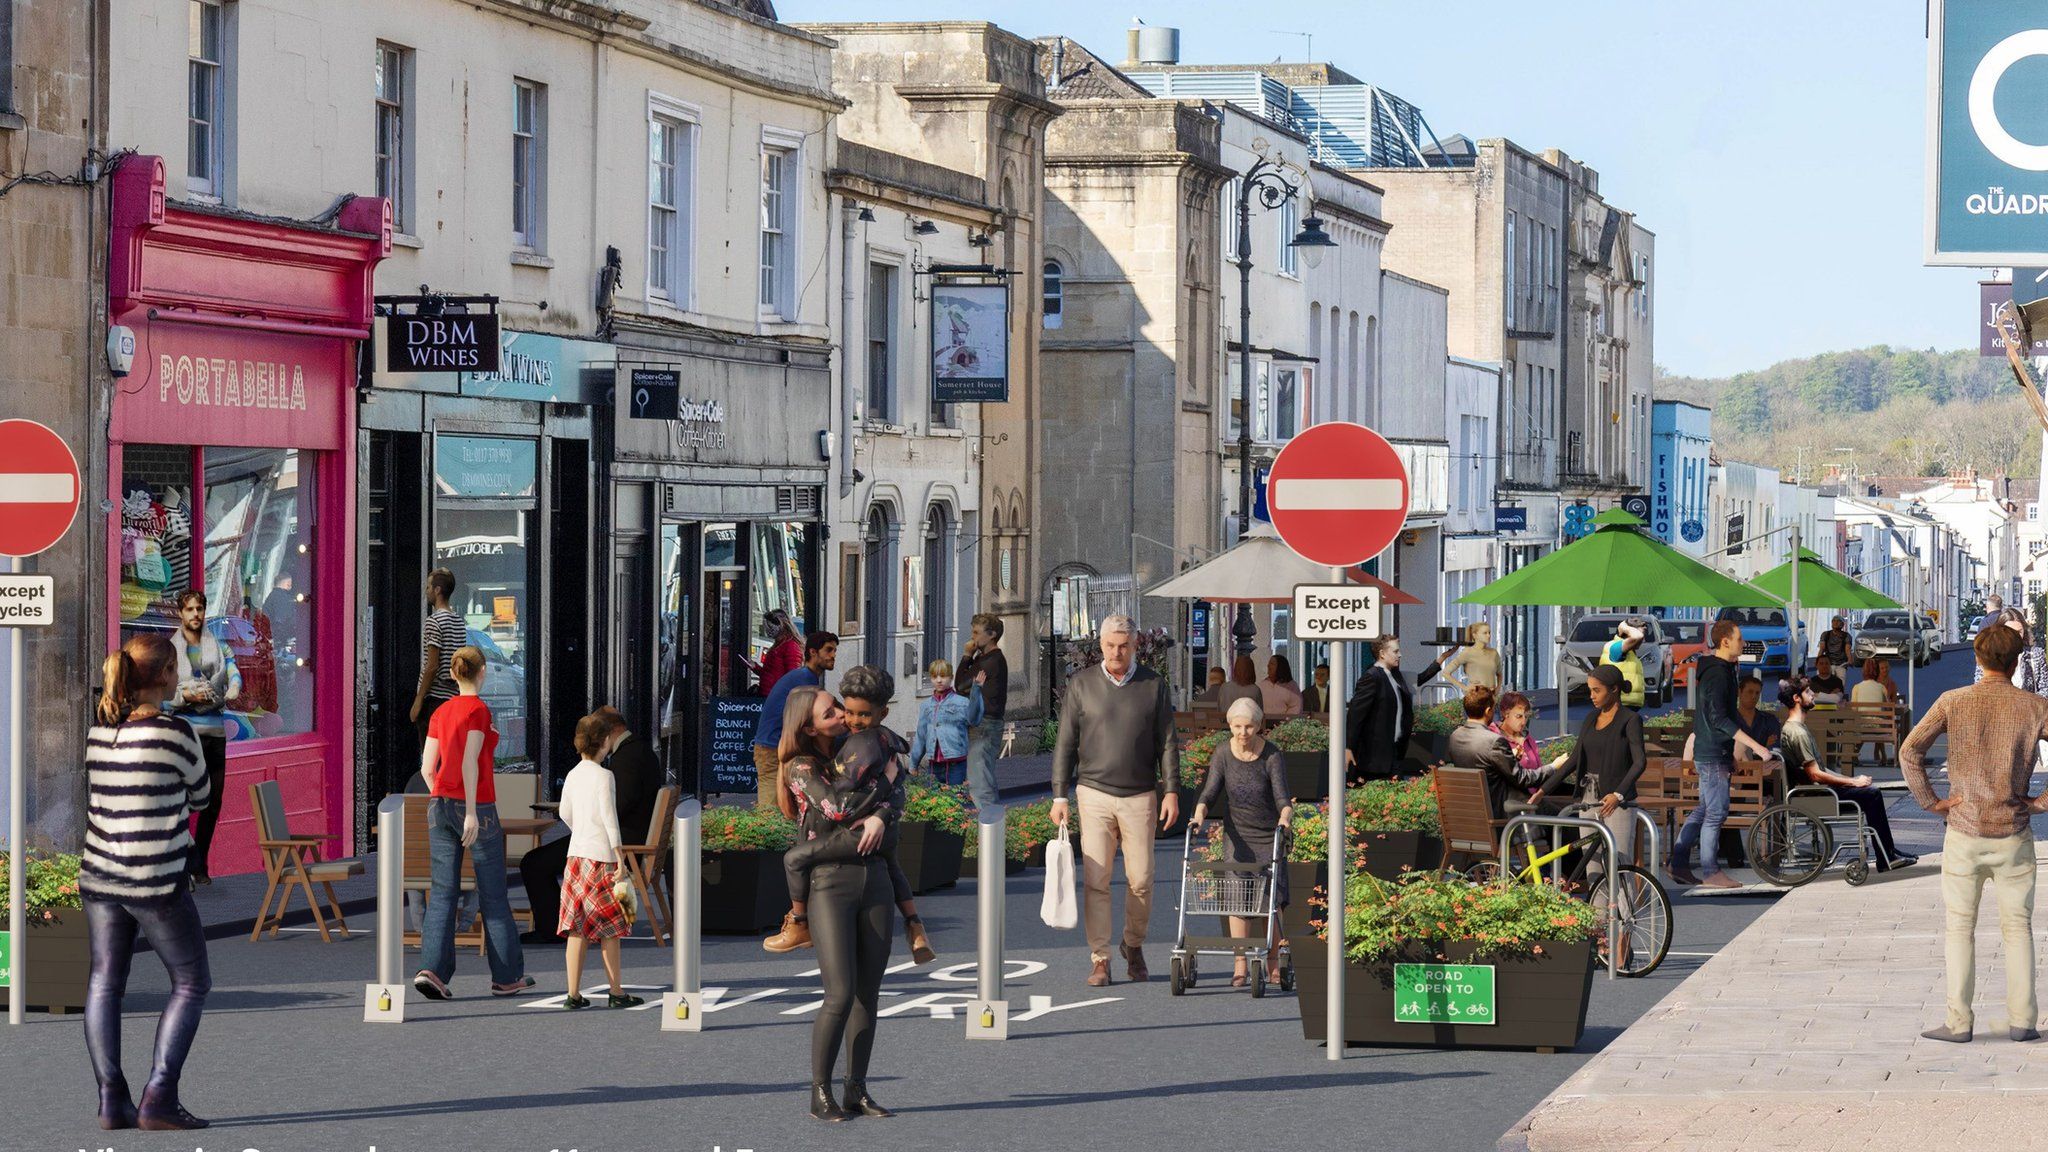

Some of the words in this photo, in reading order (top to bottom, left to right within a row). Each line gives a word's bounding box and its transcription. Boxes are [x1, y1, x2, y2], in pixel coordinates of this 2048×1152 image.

[1988, 186, 2004, 194] THE
[407, 320, 478, 345] DBM
[407, 347, 478, 366] WINES
[160, 354, 306, 410] PORTABELLA
[680, 397, 724, 425] Spicer+Cole
[1305, 595, 1370, 613] Except
[1195, 611, 1203, 621] P
[1307, 616, 1366, 633] cycles
[715, 718, 751, 728] BRUNCH
[715, 730, 743, 739] LUNCH
[713, 741, 745, 751] COFFEE
[712, 752, 737, 762] CAKE
[717, 773, 735, 784] Every
[737, 774, 751, 785] Day
[1425, 970, 1462, 981] ROAD
[1414, 984, 1451, 993] OPEN
[1456, 984, 1473, 994] TO
